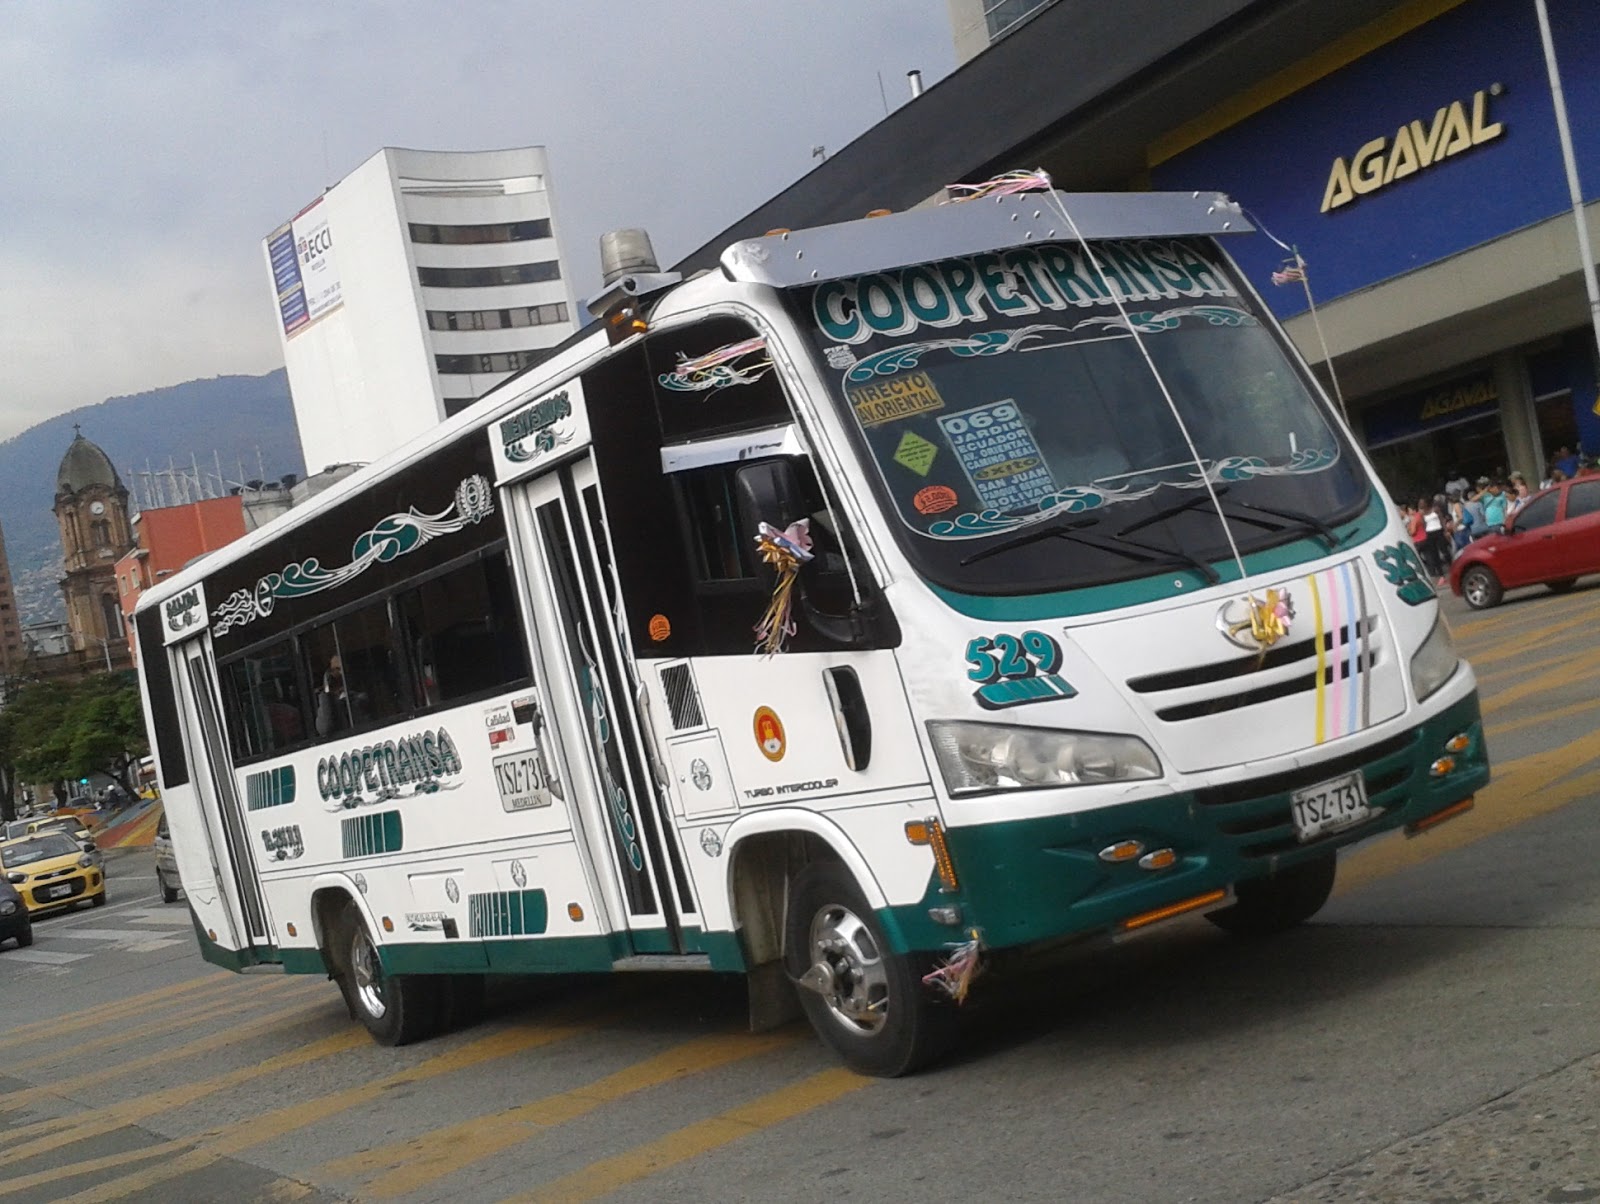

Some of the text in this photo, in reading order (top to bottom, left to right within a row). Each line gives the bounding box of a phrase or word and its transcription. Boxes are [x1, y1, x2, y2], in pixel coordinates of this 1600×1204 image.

[1320, 90, 1502, 213] AGAVAL
[308, 227, 332, 260] ECCI
[812, 241, 1238, 345] COOPETRANSA
[850, 374, 926, 405] DIRECTO
[945, 405, 1016, 434] 069
[953, 419, 1023, 445] JARDIN
[957, 429, 1028, 455] ECUADOR
[980, 438, 1031, 458] ORIENTAL
[967, 446, 1036, 470] CAMINO REAL
[978, 467, 1048, 492] SAN JUAN
[986, 484, 1056, 509] BOLIVAR
[965, 629, 1064, 684] 529
[317, 726, 462, 802] COOPETRANSA
[744, 778, 838, 798] TURBO INTERCOOLER
